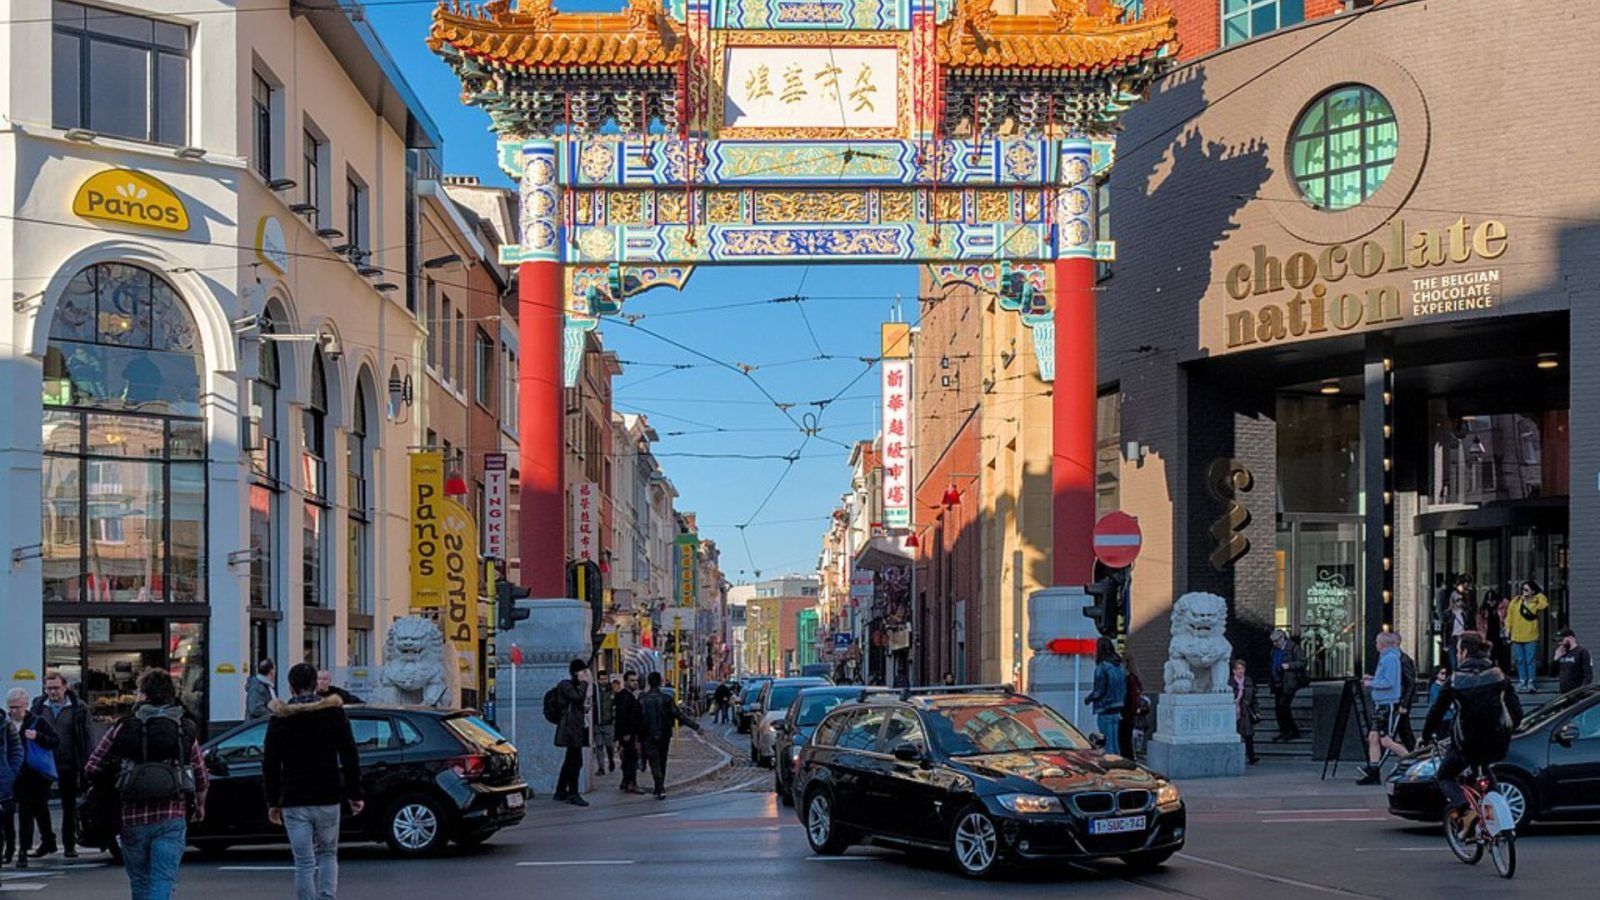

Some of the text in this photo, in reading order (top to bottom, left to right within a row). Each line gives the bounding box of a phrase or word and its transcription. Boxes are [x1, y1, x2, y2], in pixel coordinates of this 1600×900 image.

[87, 190, 179, 224] Panos
[1225, 215, 1508, 301] chocolate
[1413, 269, 1500, 291] THE BELGIAN
[1413, 284, 1491, 303] CHOCOLATE
[1227, 283, 1404, 348] nation
[1413, 296, 1493, 317] EXPERIENCE
[488, 474, 502, 518] TING
[414, 484, 439, 576] Panos
